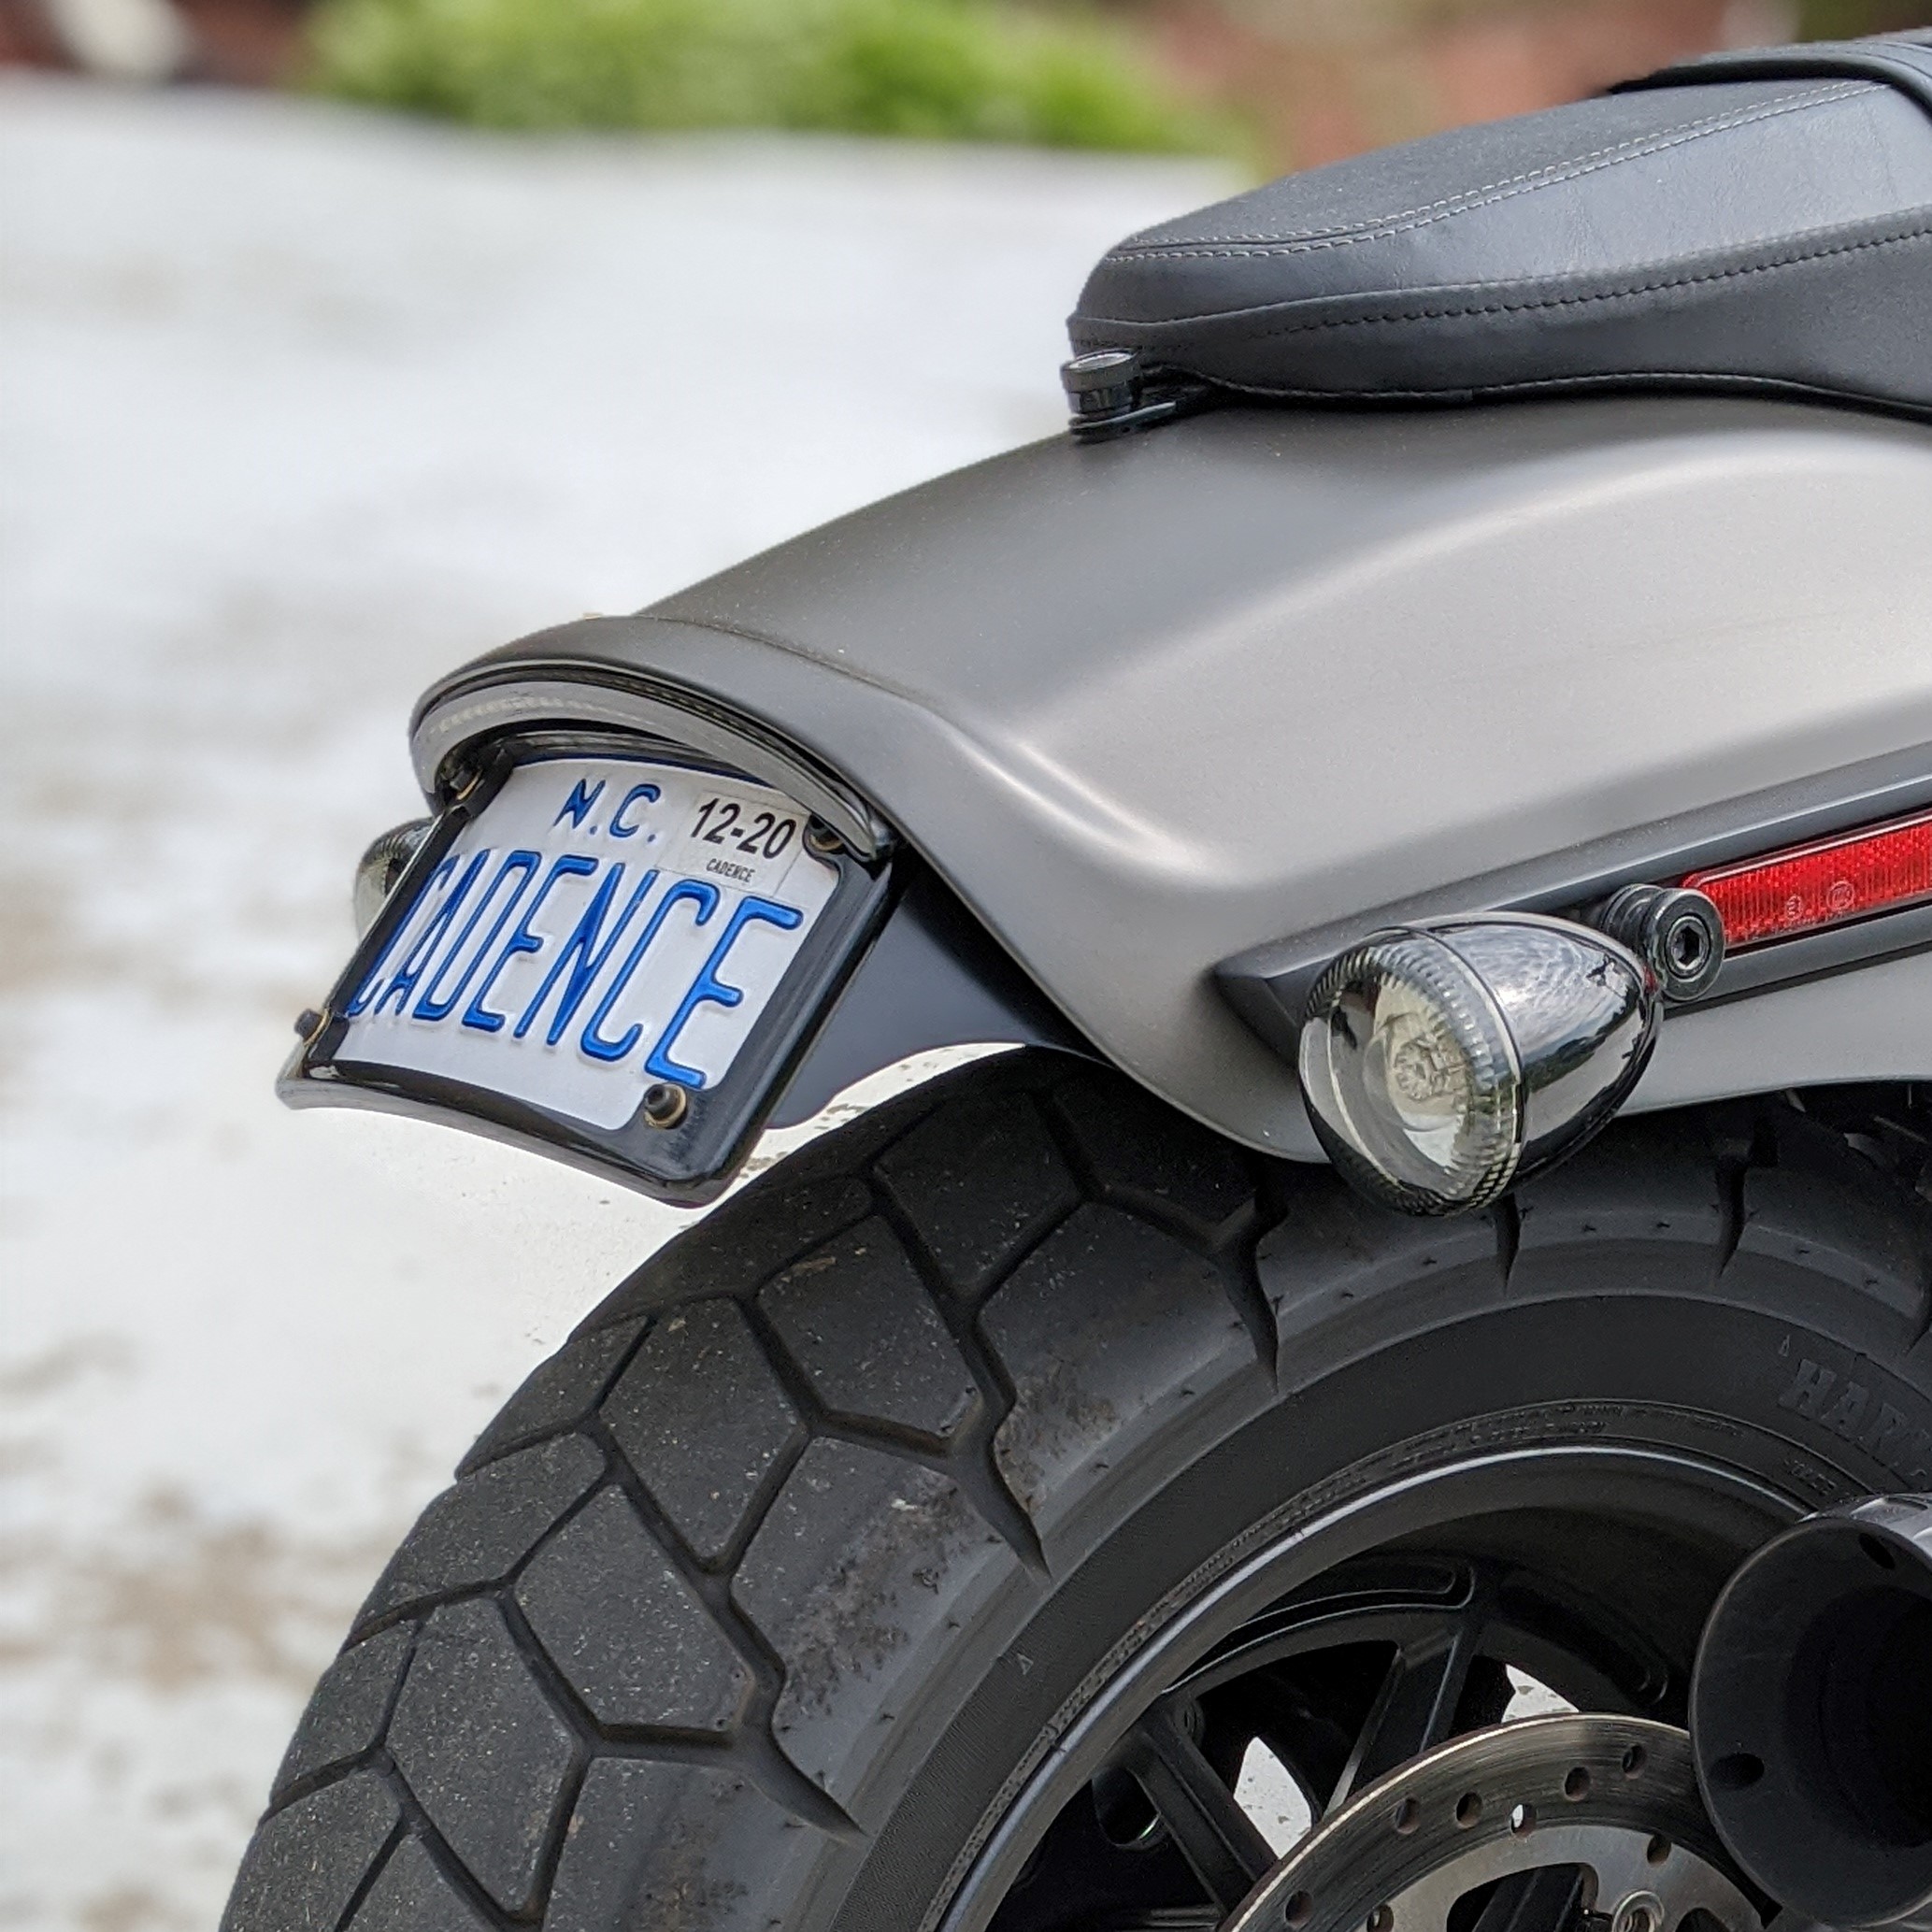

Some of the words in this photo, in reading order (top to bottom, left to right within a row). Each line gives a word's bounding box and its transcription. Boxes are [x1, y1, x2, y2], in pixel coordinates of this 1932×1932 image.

[552, 778, 662, 843] N.C.
[689, 796, 797, 860] 12-20
[705, 857, 756, 883] CADENCE
[344, 848, 803, 1091] CADENCE
